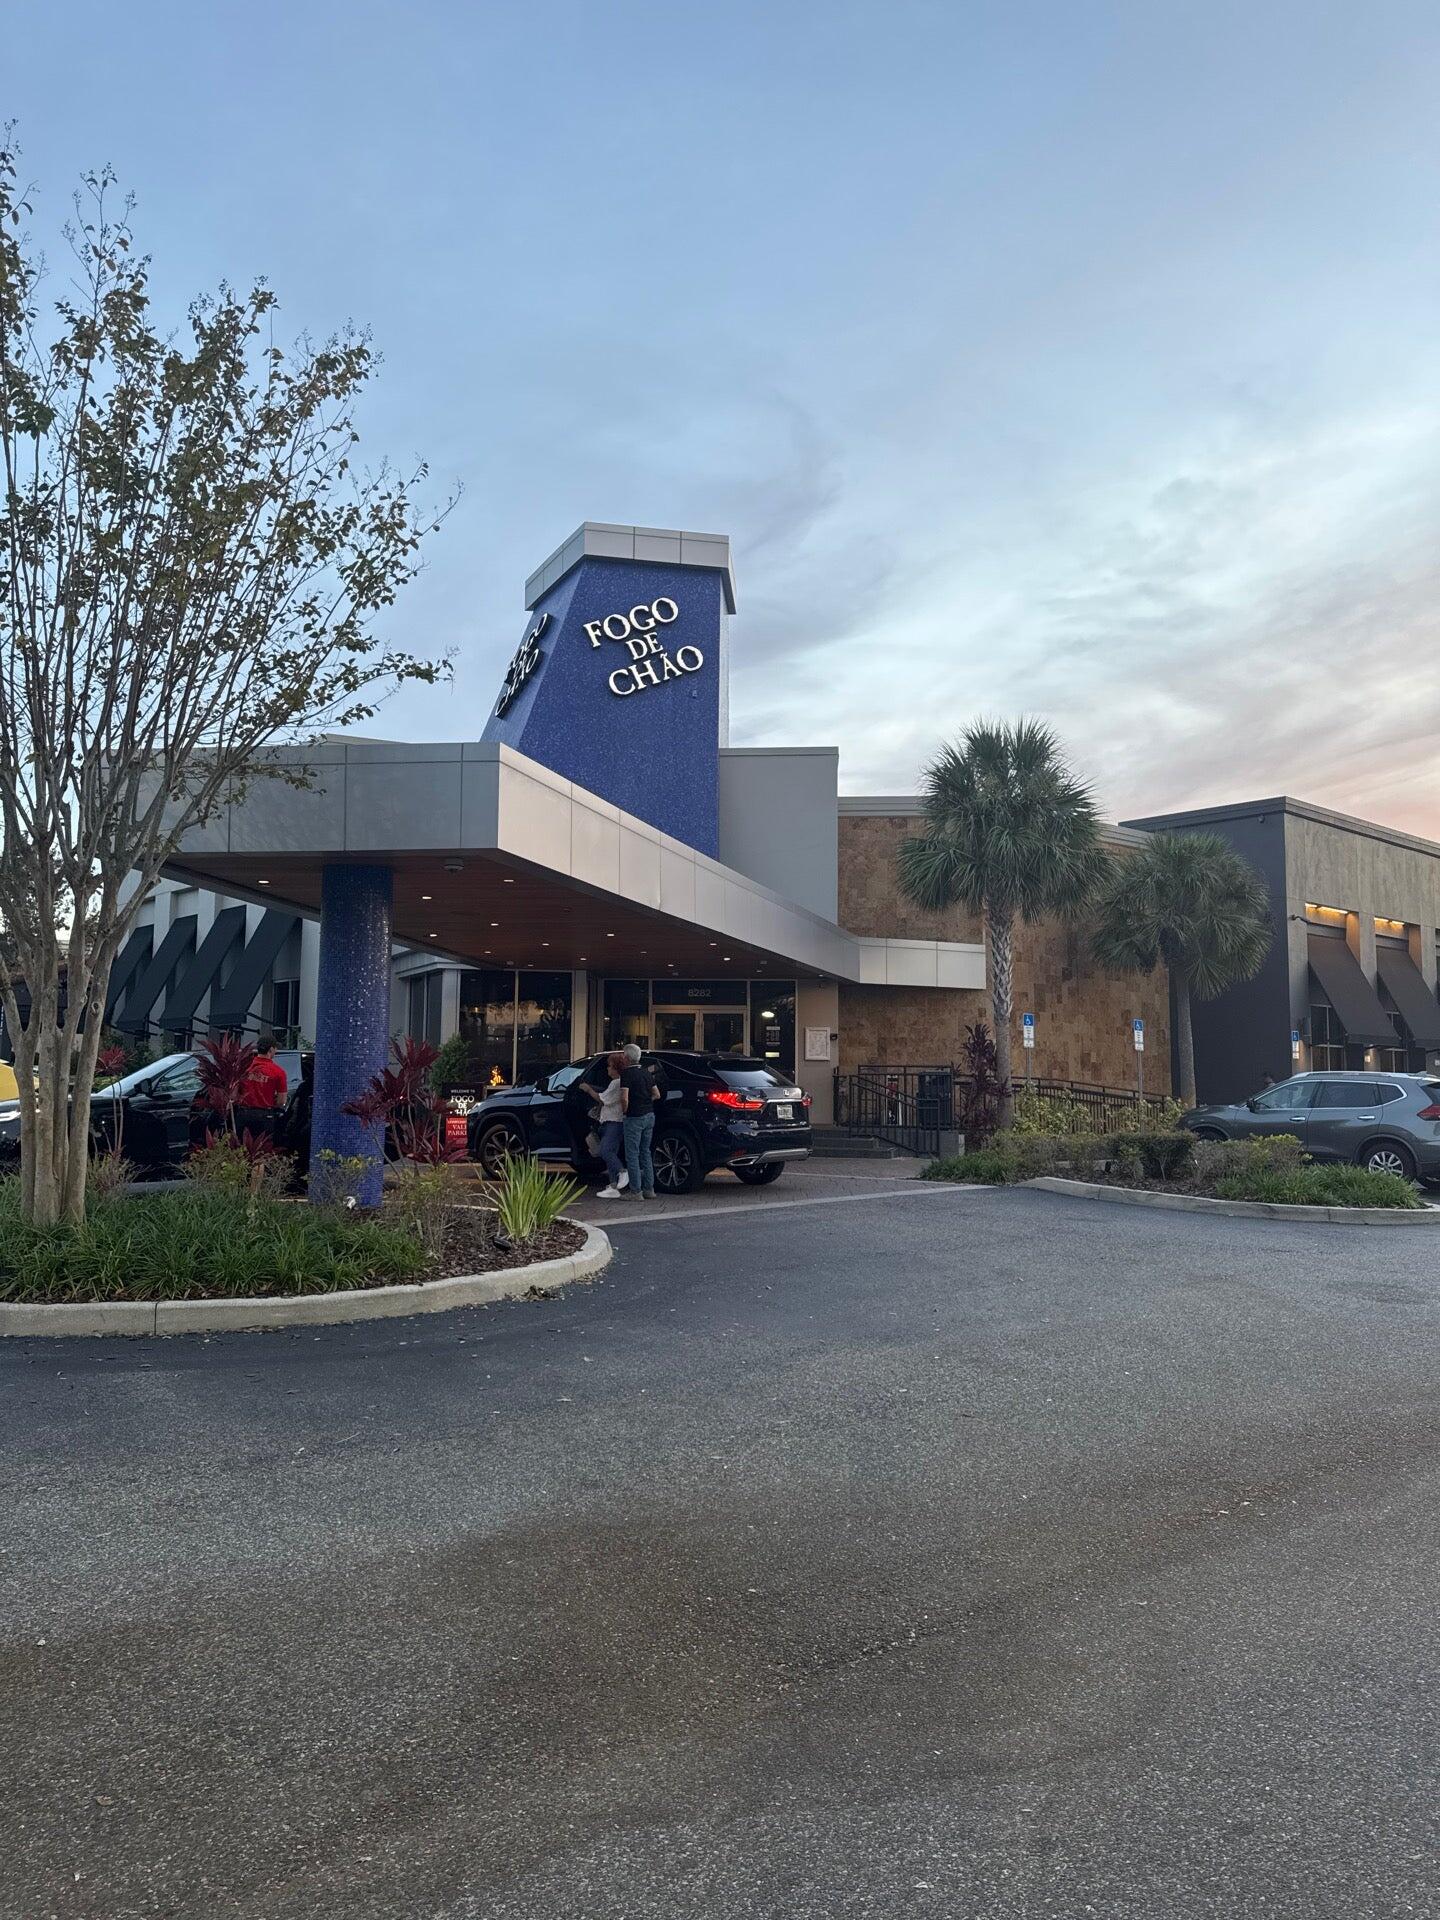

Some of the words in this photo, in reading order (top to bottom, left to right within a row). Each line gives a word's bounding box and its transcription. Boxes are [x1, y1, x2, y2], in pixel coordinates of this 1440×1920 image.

[583, 597, 679, 648] FOGO
[626, 632, 664, 661] DE
[608, 645, 704, 696] CHÃO
[688, 988, 712, 997] 8282
[451, 1095, 475, 1103] FOGO
